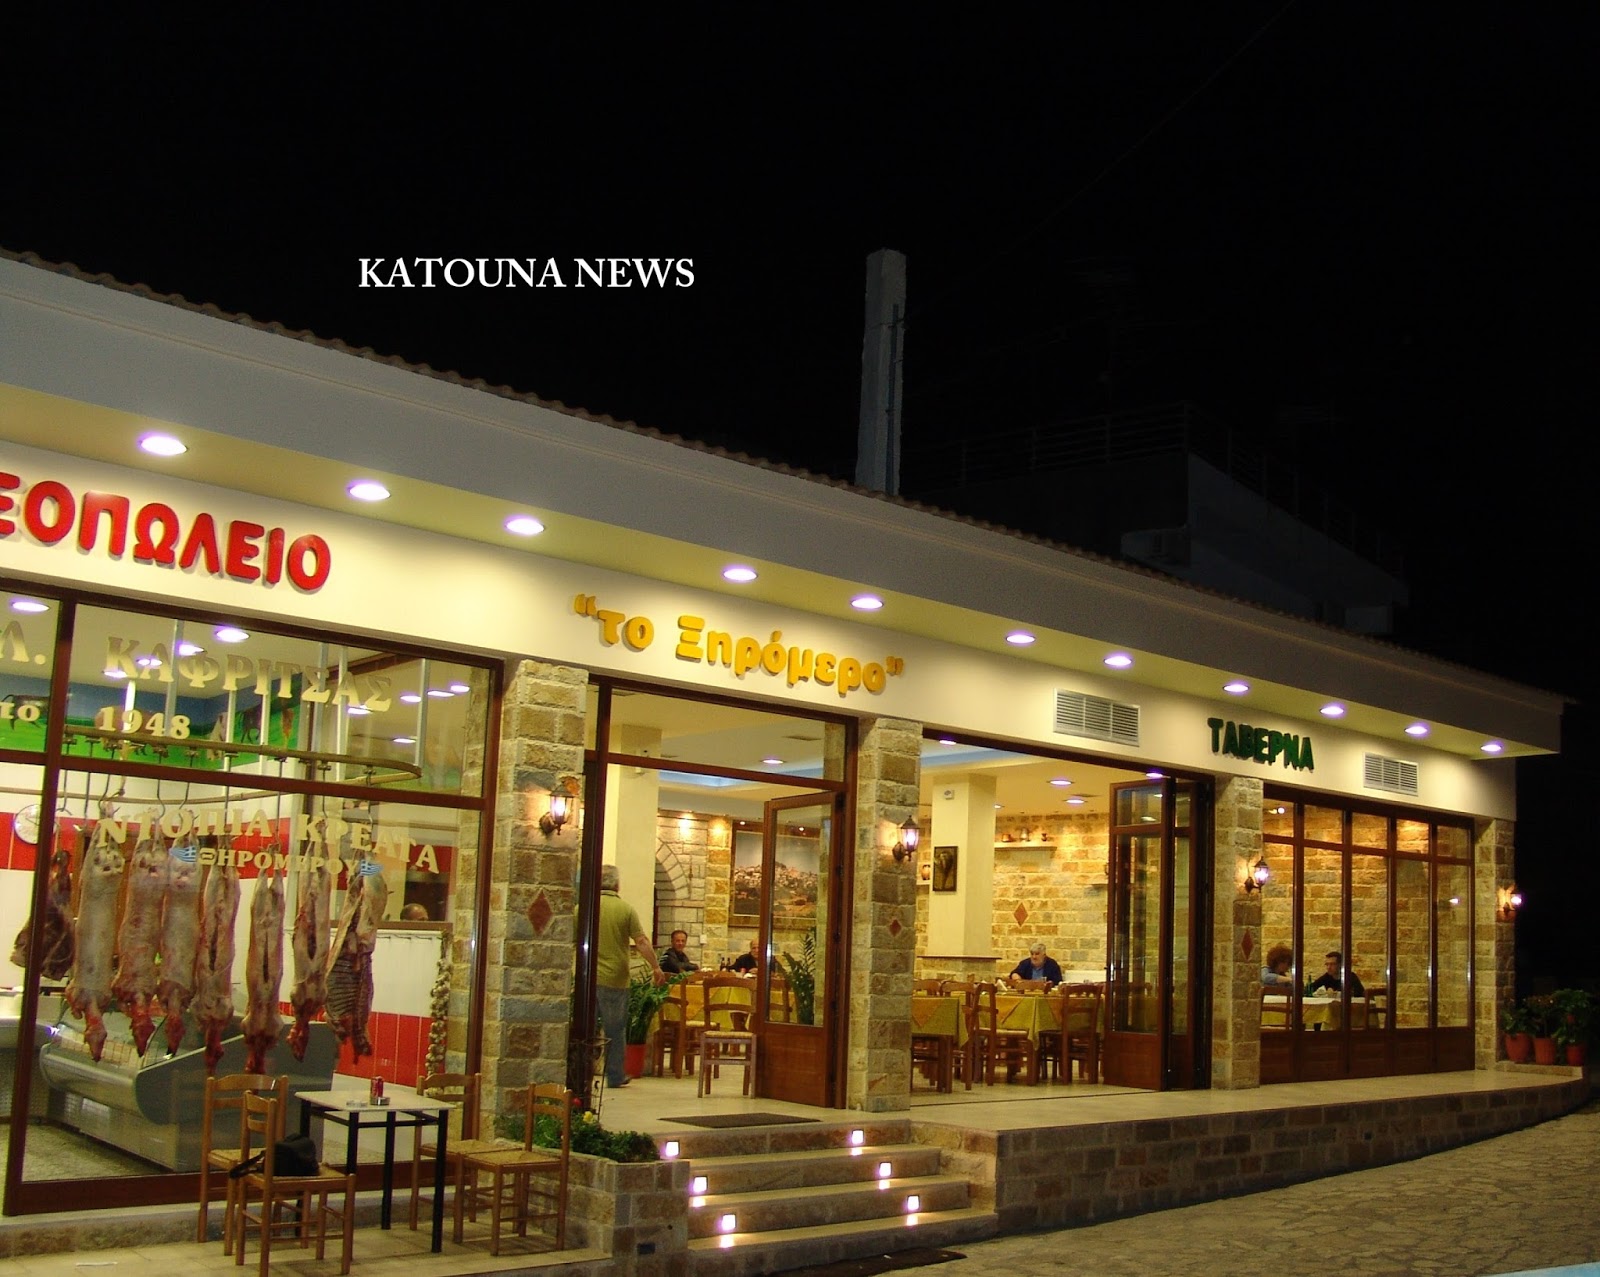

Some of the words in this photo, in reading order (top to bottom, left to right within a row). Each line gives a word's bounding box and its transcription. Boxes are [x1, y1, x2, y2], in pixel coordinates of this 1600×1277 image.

[107, 636, 392, 712] ΚΑΦΡΙΤΣΑΣ
[98, 706, 191, 739] 1948
[1207, 717, 1314, 772] ΤΑΒΕΡΝΑ
[97, 807, 273, 849] ΝΤΟΠΙΑ
[299, 813, 440, 874] ΚΡΕΑΤΑ
